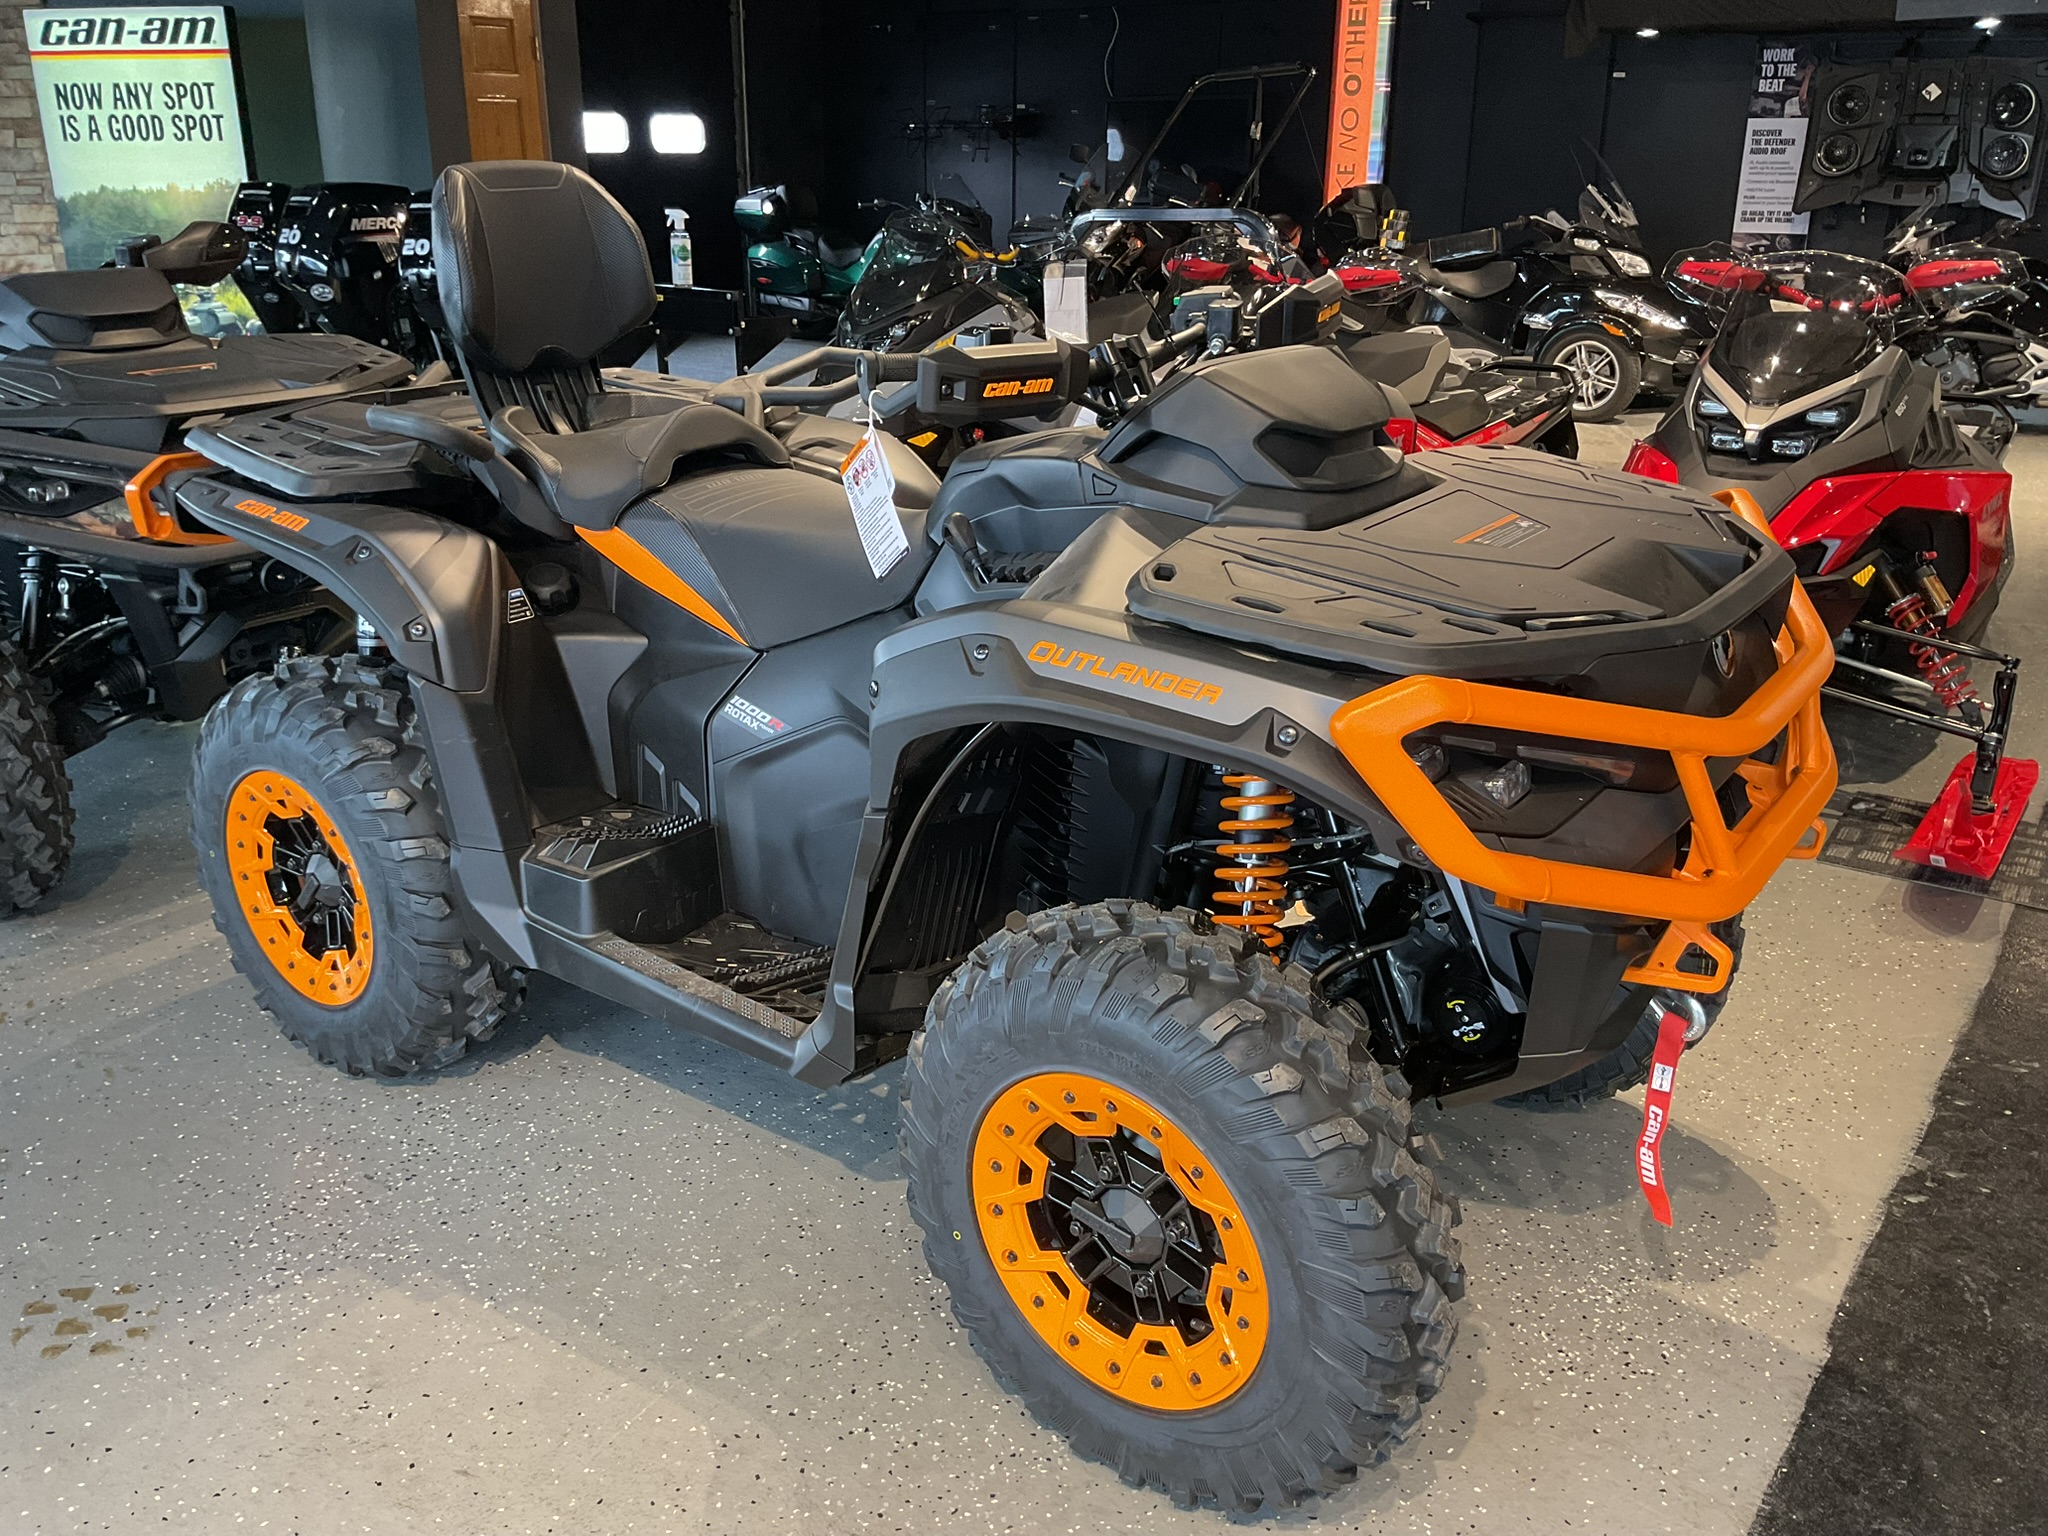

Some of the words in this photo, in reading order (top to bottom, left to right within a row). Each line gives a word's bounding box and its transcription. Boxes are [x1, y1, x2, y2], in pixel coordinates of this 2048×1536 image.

[40, 16, 216, 46] can-am
[1342, 0, 1370, 97] OTHE
[1763, 48, 1796, 62] WORK
[1761, 64, 1775, 77] TO
[1778, 63, 1798, 77] THE
[54, 83, 103, 110] NOW
[112, 82, 152, 110] ANY
[161, 82, 215, 110] SPOT
[1758, 79, 1785, 93] BEAT
[59, 115, 81, 142] IS
[87, 115, 103, 142] A
[107, 114, 165, 142] GOOD
[171, 114, 224, 142] SPOT
[1338, 107, 1360, 152] NO
[1752, 129, 1783, 137] DISCOVER
[1749, 147, 1769, 155] AUDIO
[1770, 147, 1788, 155] ROOF
[1751, 138, 1762, 146] THE
[1764, 138, 1796, 147] DEFENDER
[278, 228, 301, 245] 20
[402, 238, 430, 256] 20
[982, 377, 1054, 398] can-am
[234, 499, 310, 532] can-am
[1027, 640, 1223, 705] OUTLANDER
[723, 702, 760, 731] ROTAX
[1639, 1103, 1664, 1187] can-am
